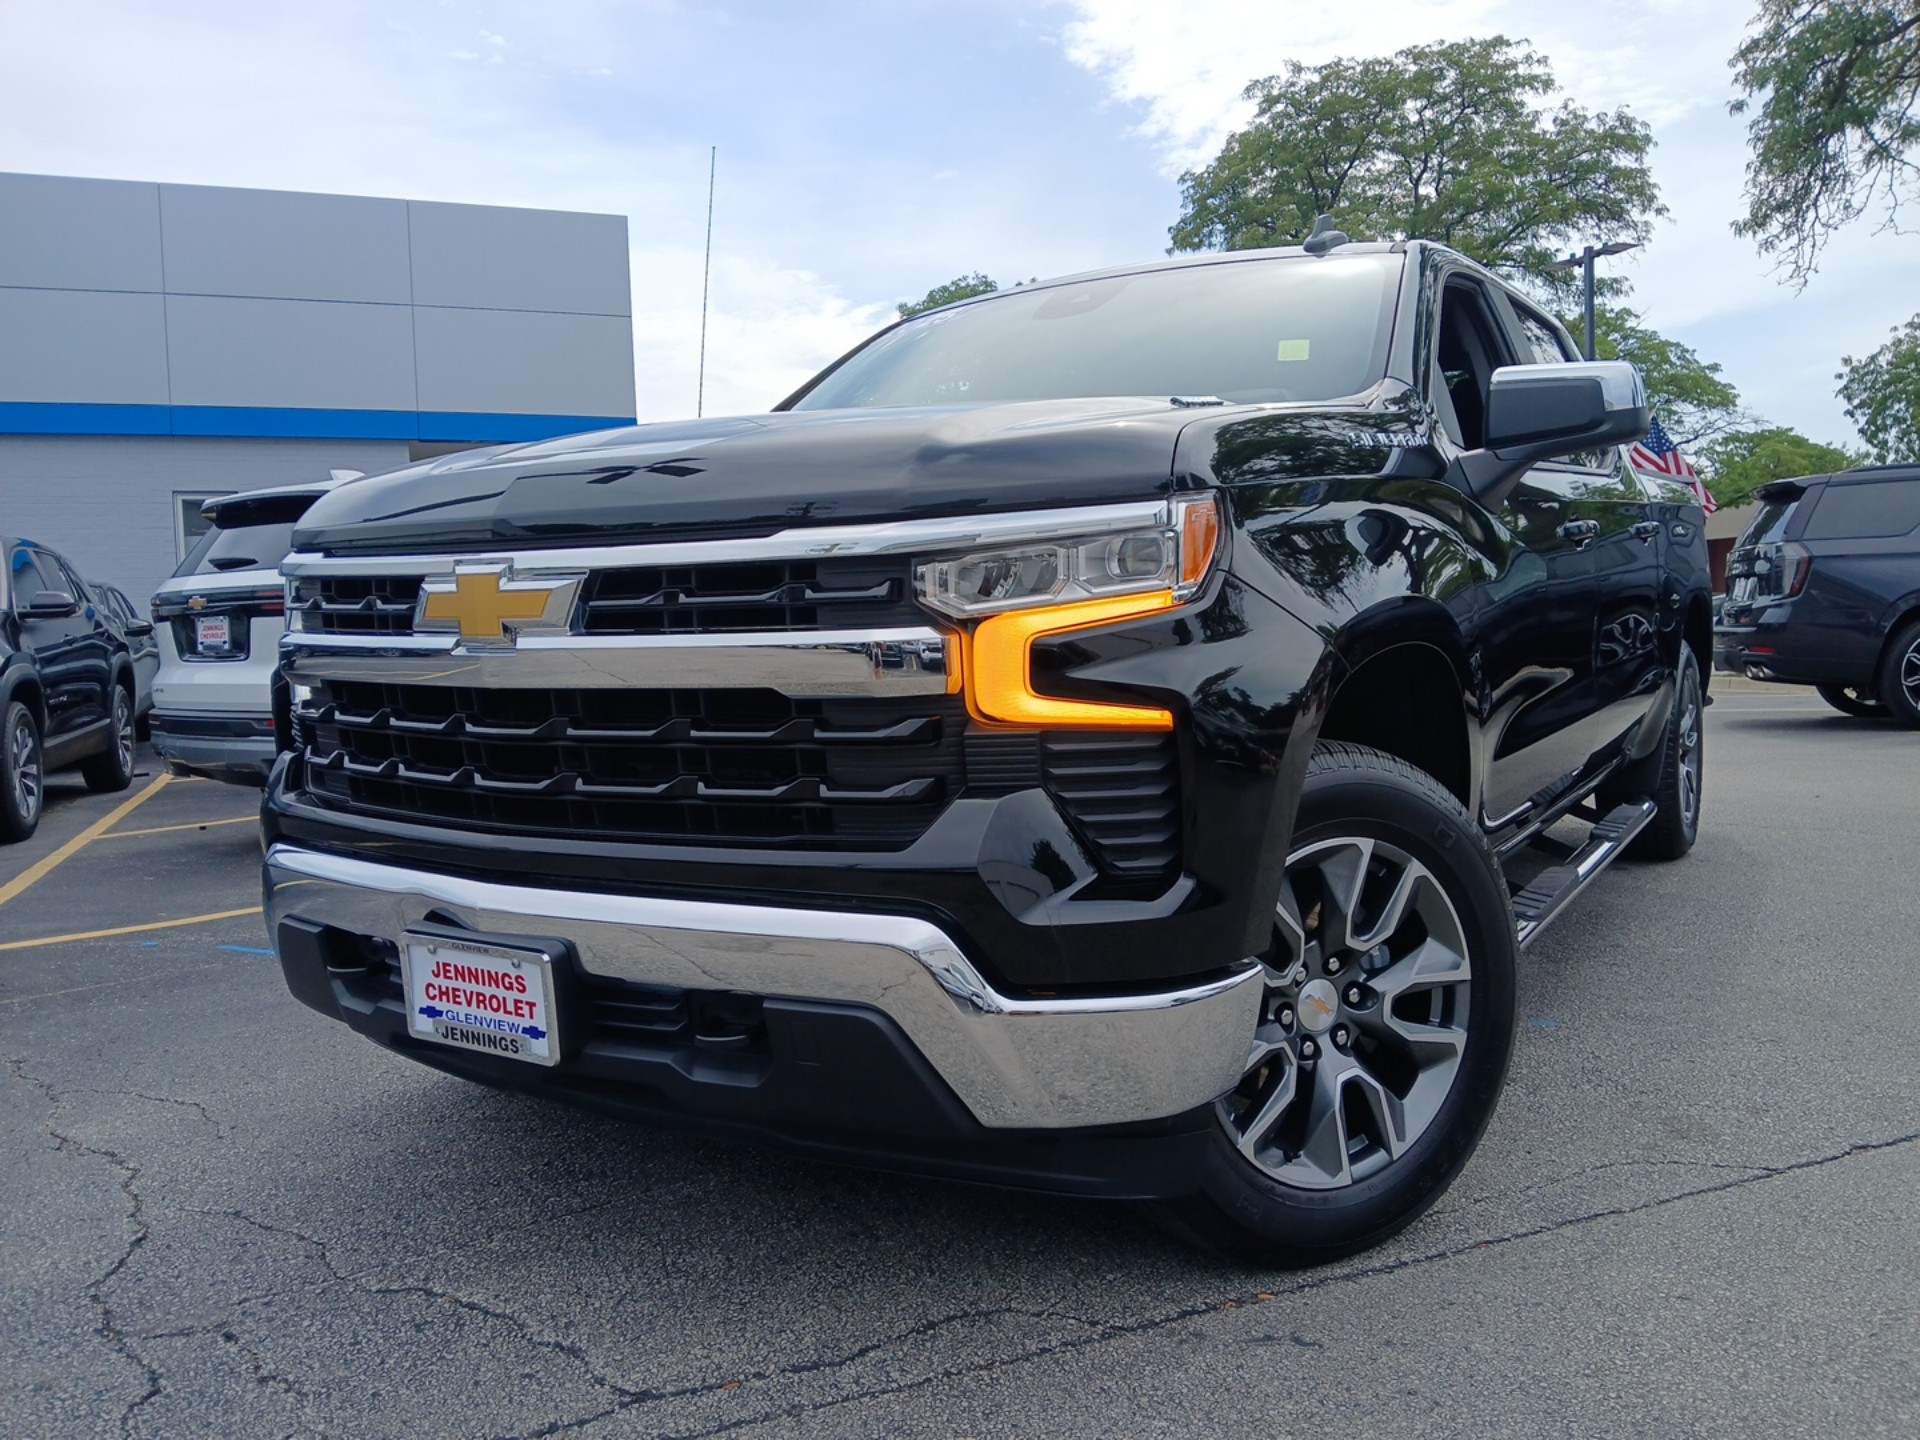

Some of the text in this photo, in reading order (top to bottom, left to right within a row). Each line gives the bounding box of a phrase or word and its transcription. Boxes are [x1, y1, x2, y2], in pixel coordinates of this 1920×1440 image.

[432, 961, 527, 994] JENNINGS
[425, 982, 537, 1020] CHEVROLET
[445, 1009, 521, 1034] GLENVIEW
[442, 1026, 520, 1054] JENNINGS
